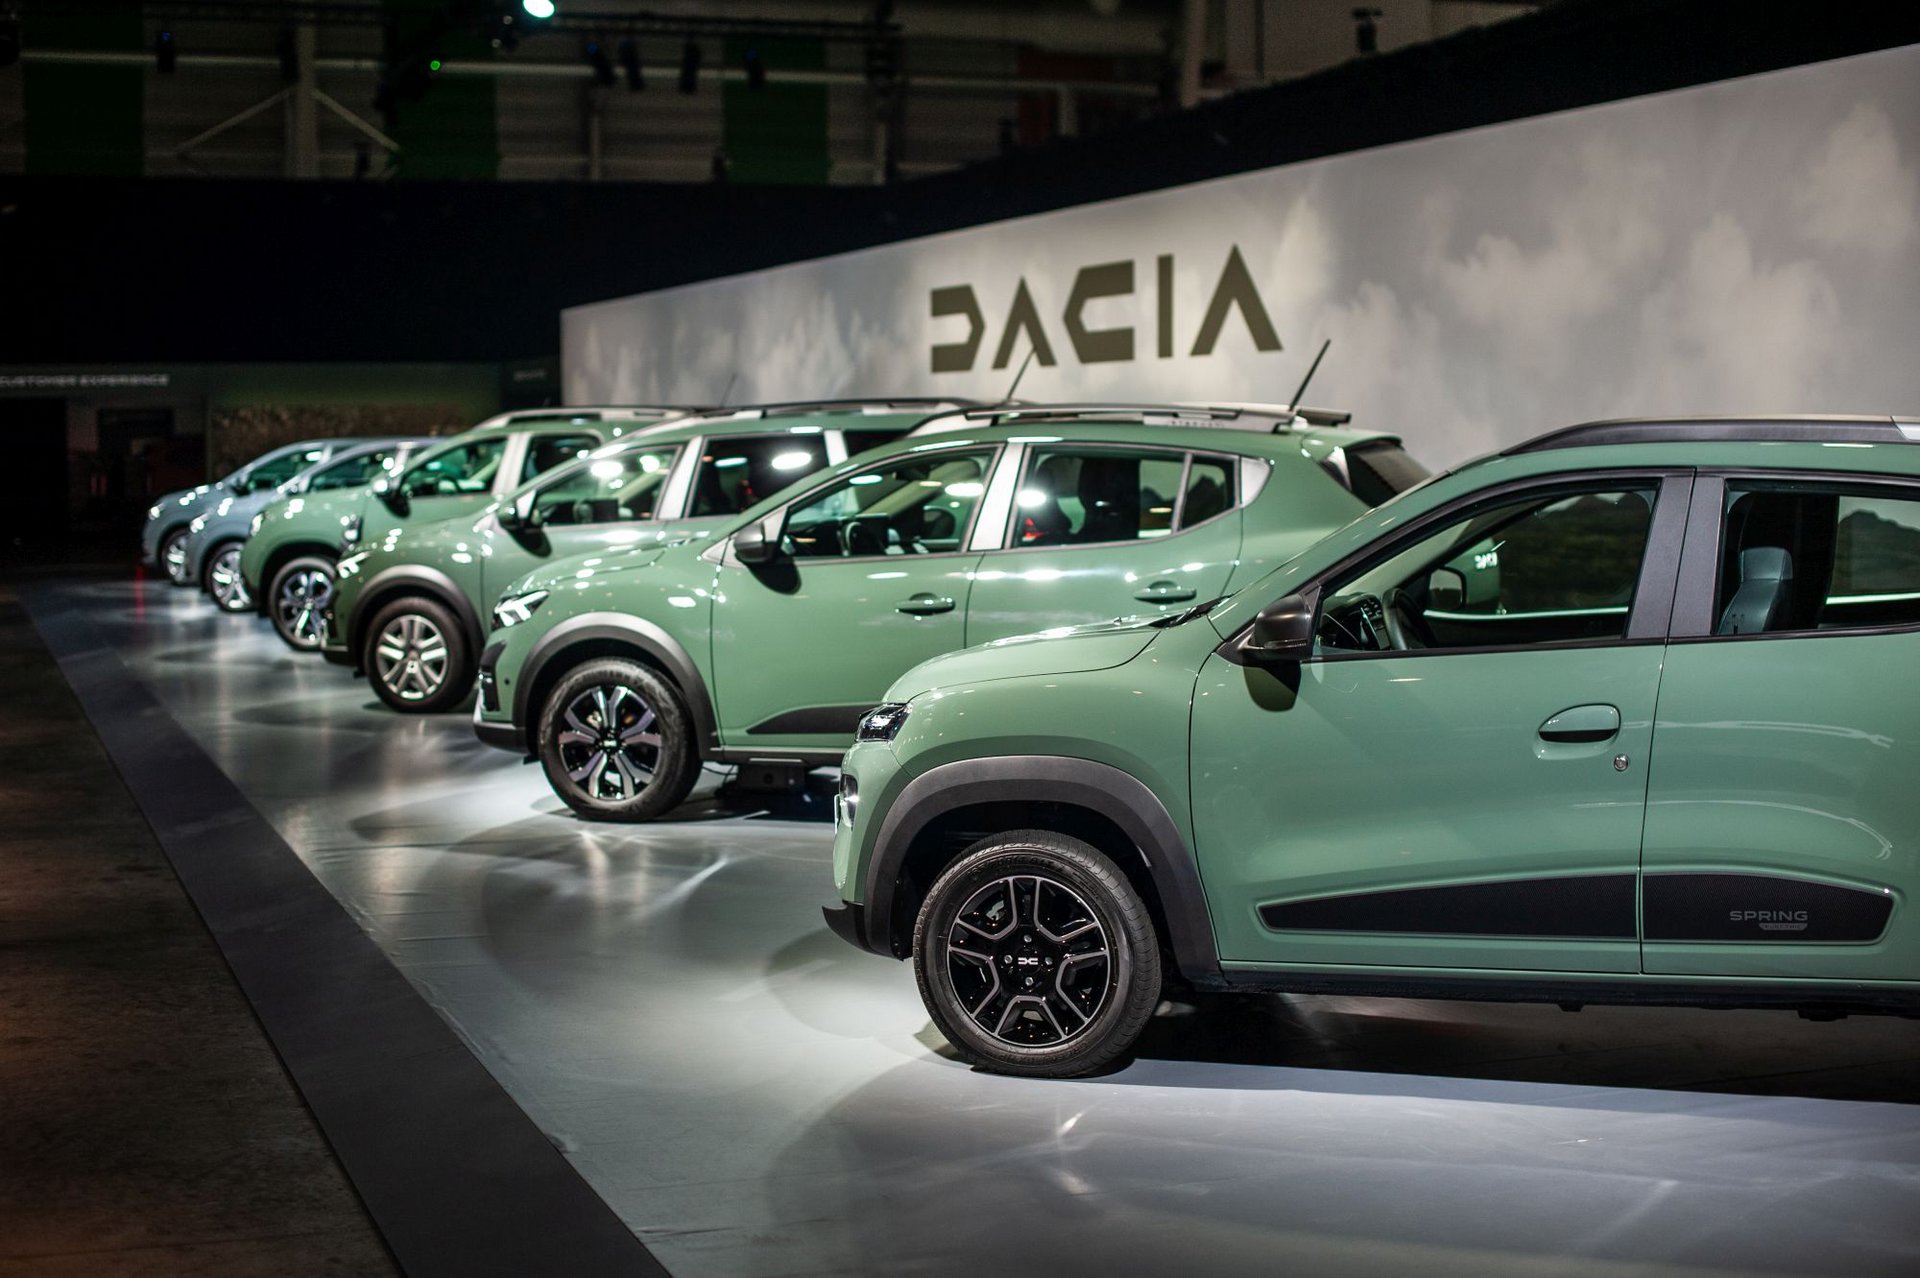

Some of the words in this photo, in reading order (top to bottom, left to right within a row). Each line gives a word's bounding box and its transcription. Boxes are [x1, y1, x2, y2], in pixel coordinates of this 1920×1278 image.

[930, 243, 1283, 373] DACIA
[80, 374, 169, 386] EXPERIENCE
[1729, 910, 1809, 921] SPRING
